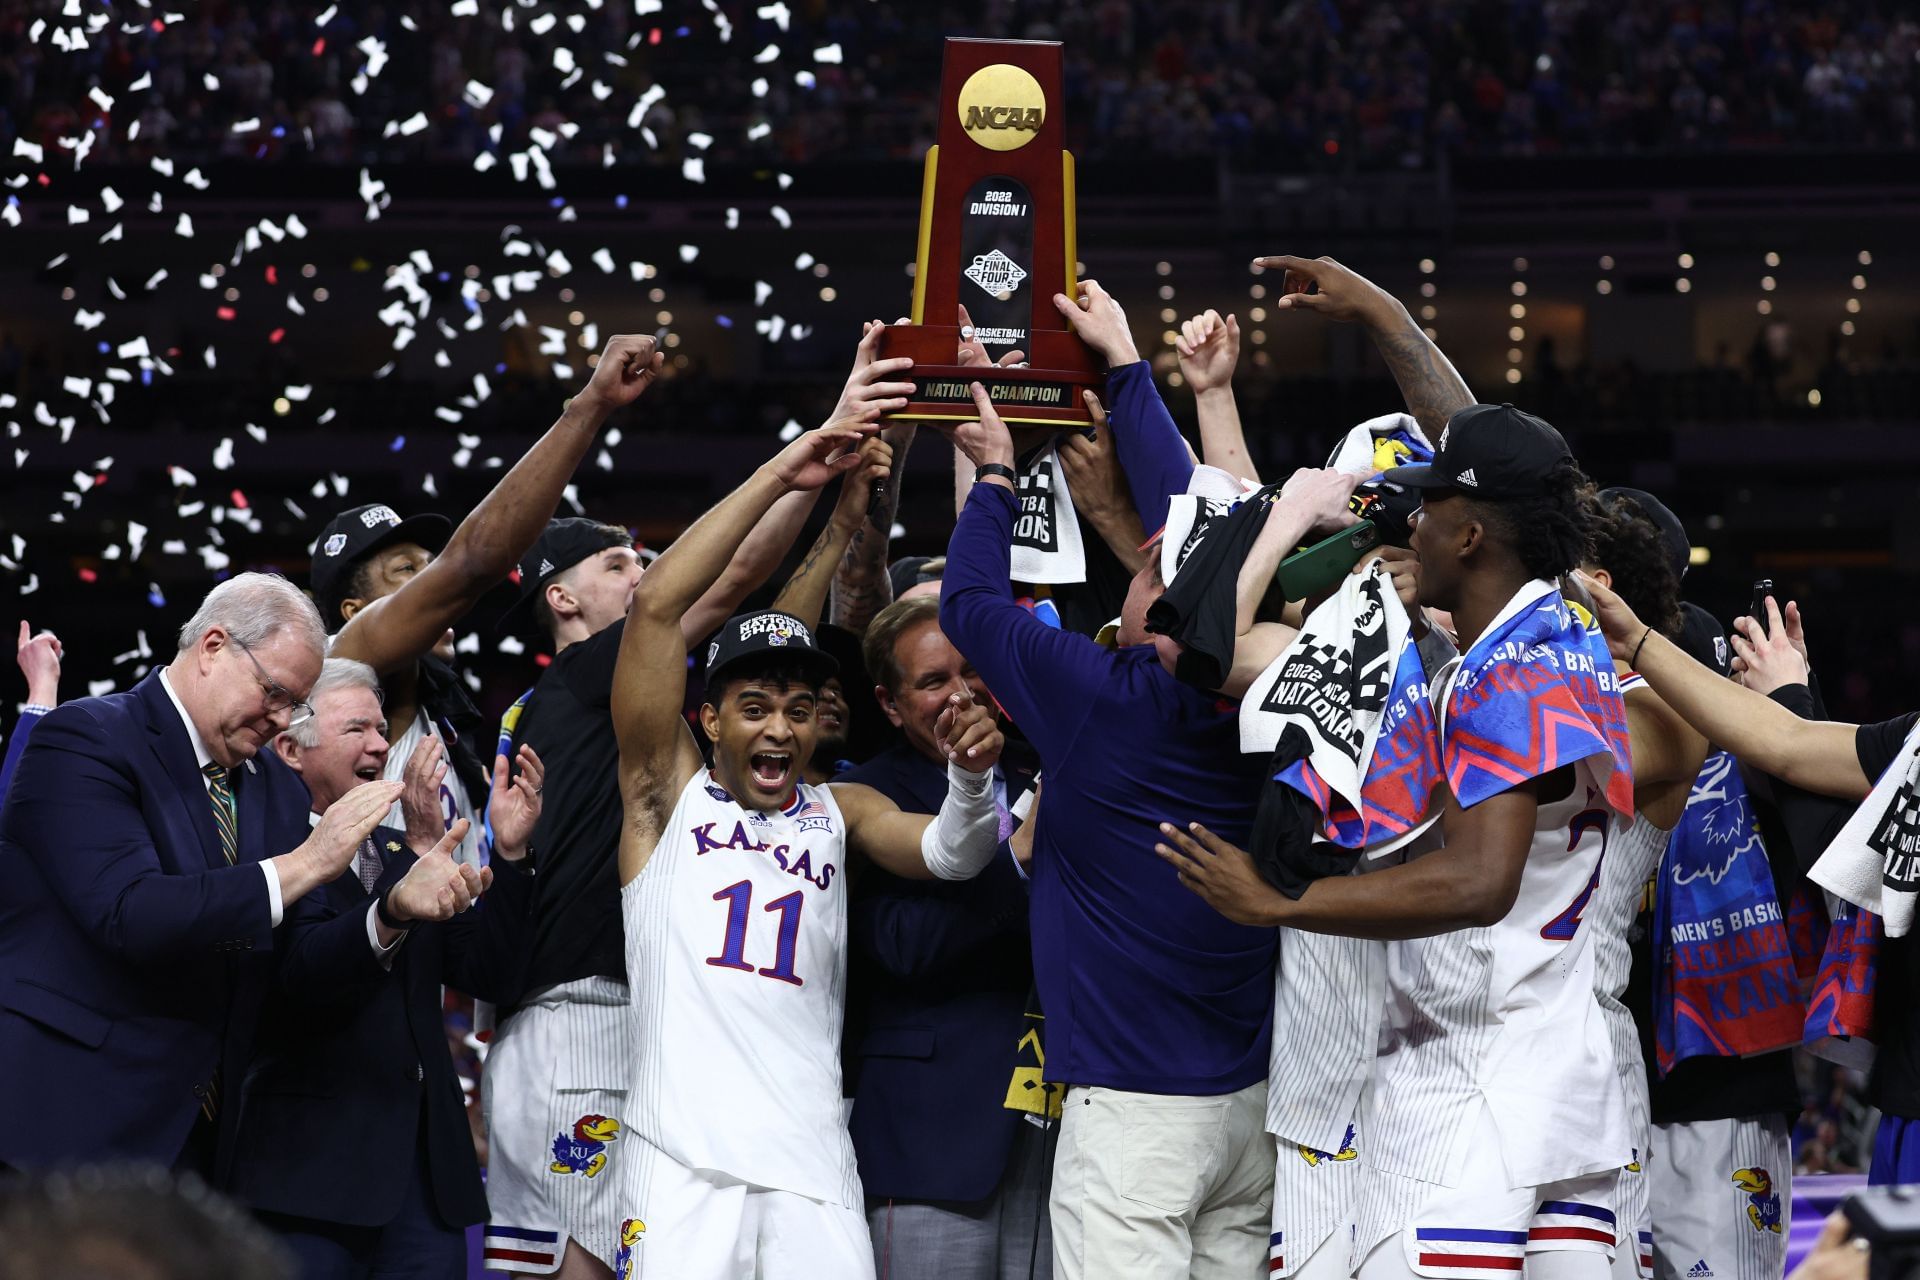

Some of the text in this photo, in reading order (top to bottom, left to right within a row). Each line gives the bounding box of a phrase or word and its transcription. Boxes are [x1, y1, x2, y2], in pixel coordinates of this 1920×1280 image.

[965, 106, 1042, 132] NCAA
[985, 191, 1012, 202] 2022
[970, 203, 1019, 216] DIVISION
[983, 261, 1010, 272] FINAL
[981, 272, 1009, 283] FOUR
[975, 327, 1025, 338] BASKETBALL
[925, 383, 1061, 403] NATION CHAMPION
[1457, 475, 1478, 487] adidas
[1284, 663, 1323, 683] 2022
[706, 879, 804, 987] 11
[1670, 918, 1725, 944] MEN'S
[570, 1147, 588, 1159] KU
[1763, 1203, 1774, 1215] KU
[1687, 1270, 1714, 1278] adidas
